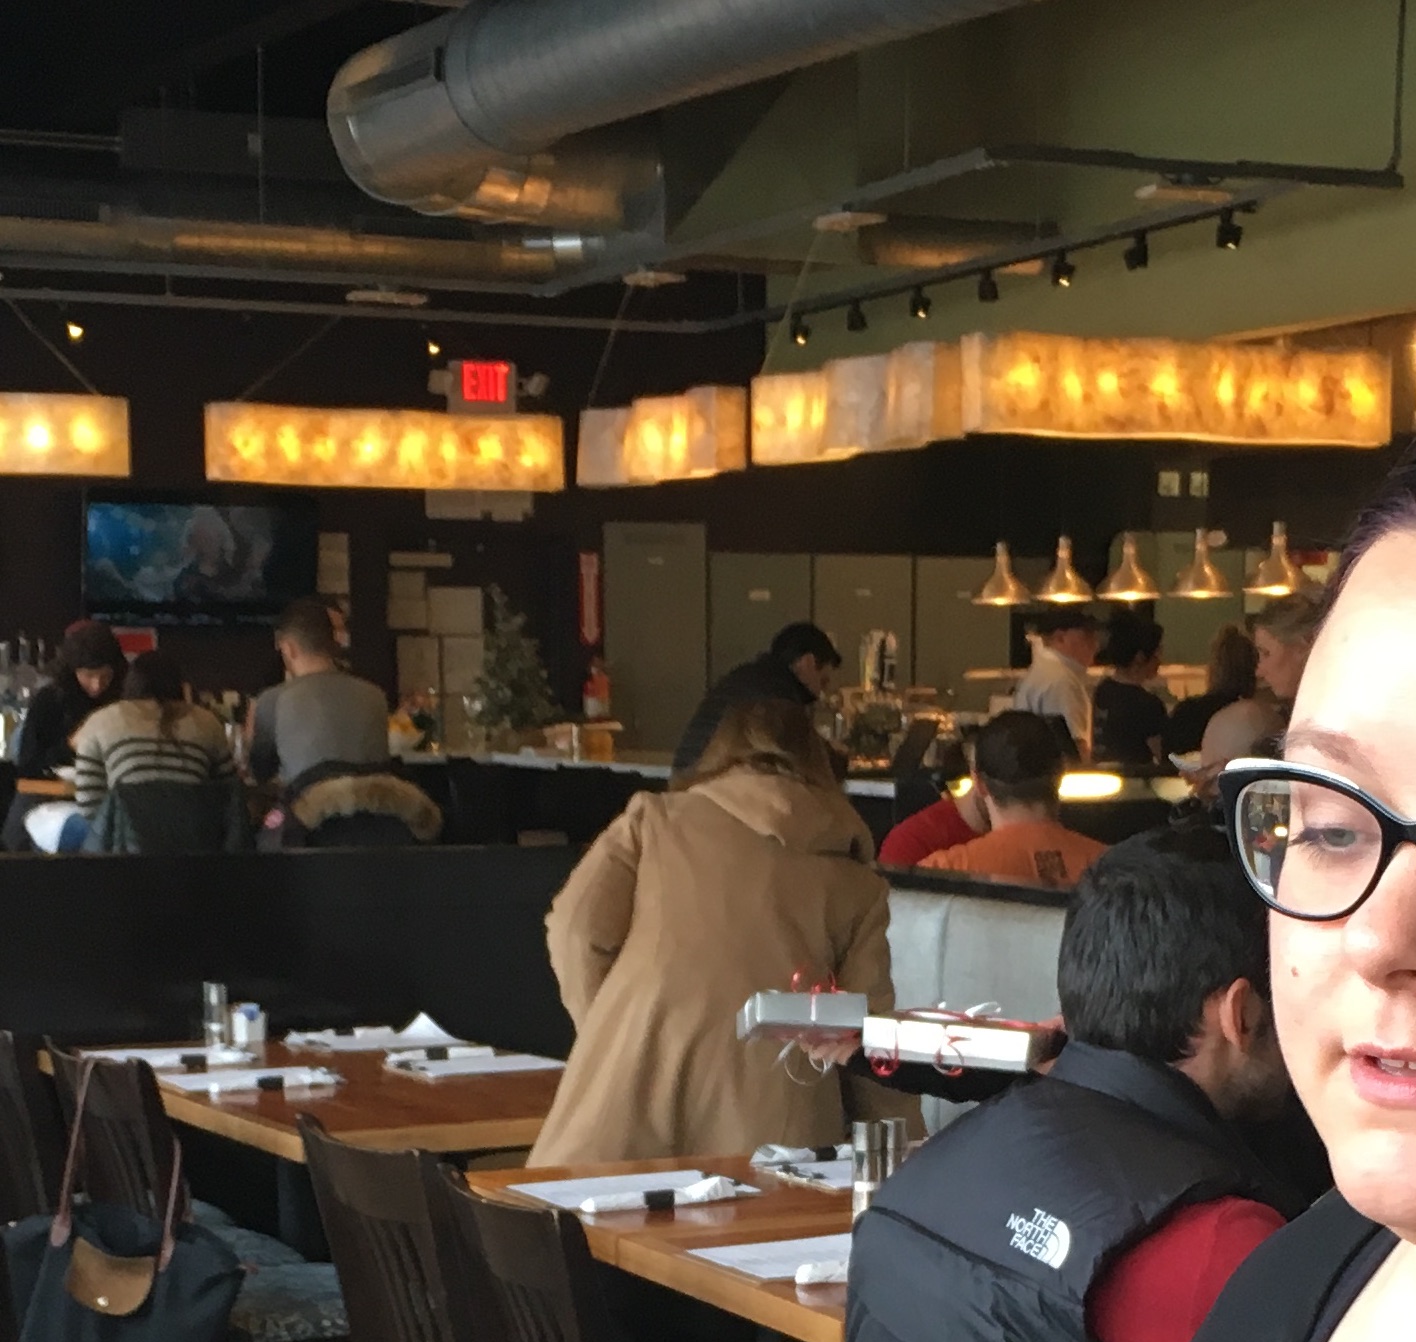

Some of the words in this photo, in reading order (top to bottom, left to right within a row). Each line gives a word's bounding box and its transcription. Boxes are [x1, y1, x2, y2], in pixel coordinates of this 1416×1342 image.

[462, 361, 509, 402] EXIT
[1005, 1213, 1051, 1245] NORTH
[1032, 1208, 1058, 1232] THE
[1009, 1233, 1043, 1259] FACE
